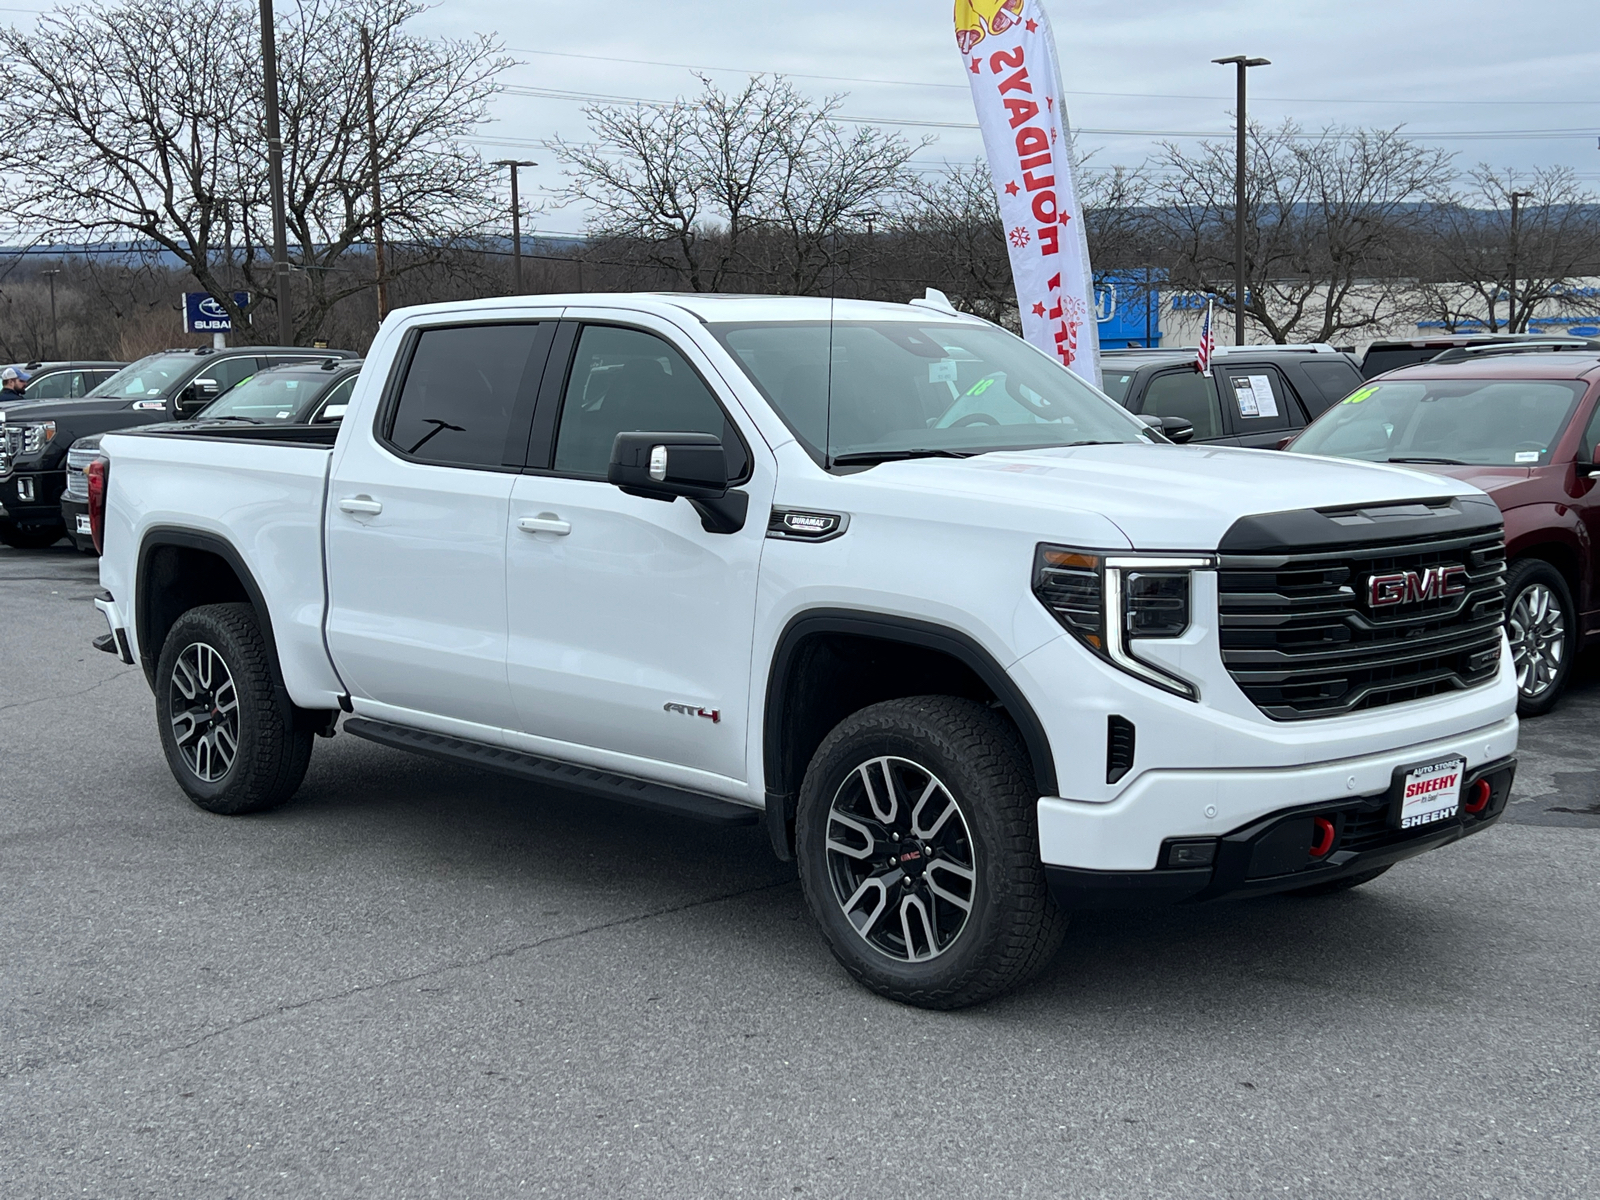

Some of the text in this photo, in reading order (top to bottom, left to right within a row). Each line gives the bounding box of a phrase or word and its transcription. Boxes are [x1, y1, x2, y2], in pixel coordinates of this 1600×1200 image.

[194, 320, 232, 329] SUBA
[966, 379, 995, 396] 18
[1342, 386, 1380, 405] 16
[791, 516, 825, 527] DURAMAX
[1368, 565, 1465, 608] GMC
[663, 701, 721, 724] AT4
[1413, 759, 1461, 776] AUTO STORES
[1406, 773, 1458, 798] SHEEHY
[1401, 806, 1459, 829] SHEEHY
